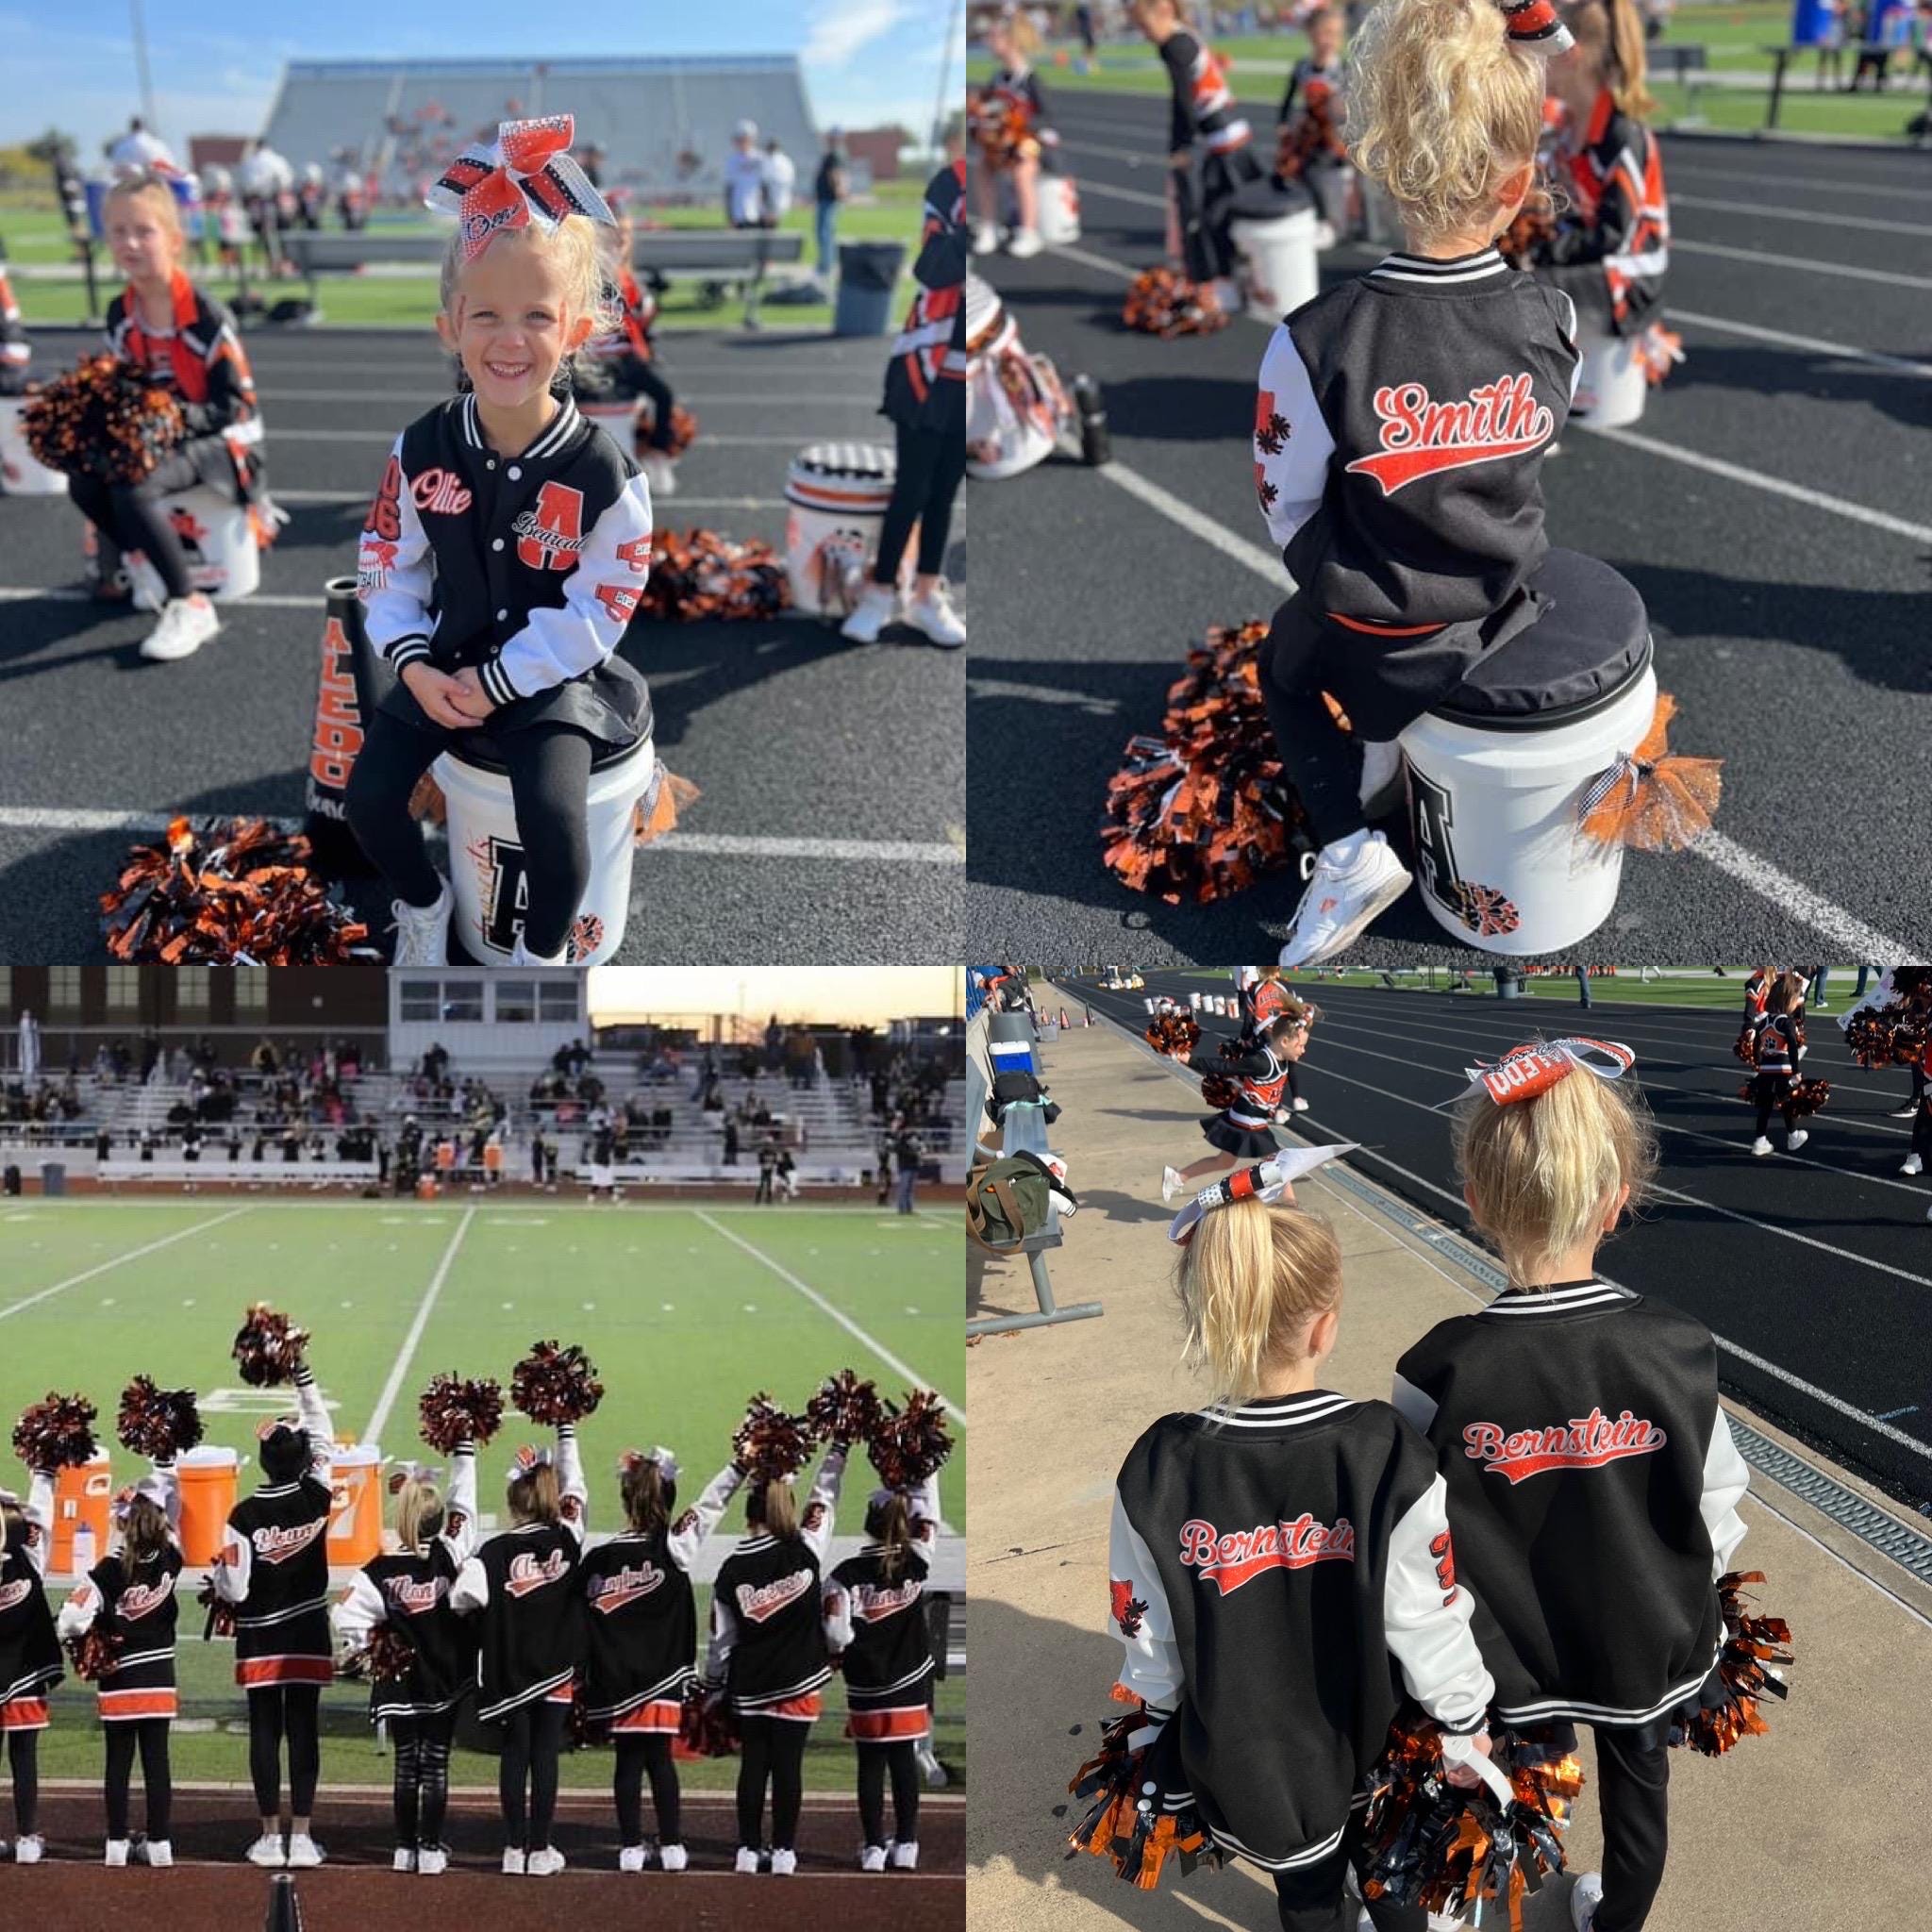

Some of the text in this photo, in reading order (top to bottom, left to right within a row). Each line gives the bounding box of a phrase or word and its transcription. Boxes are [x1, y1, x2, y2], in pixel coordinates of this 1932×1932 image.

[1372, 372, 1552, 457] Smith
[411, 468, 472, 515] Ollie
[309, 616, 365, 790] ALEDO
[1461, 1406, 1654, 1461] Bernstein
[1179, 1512, 1356, 1567] Bernstein
